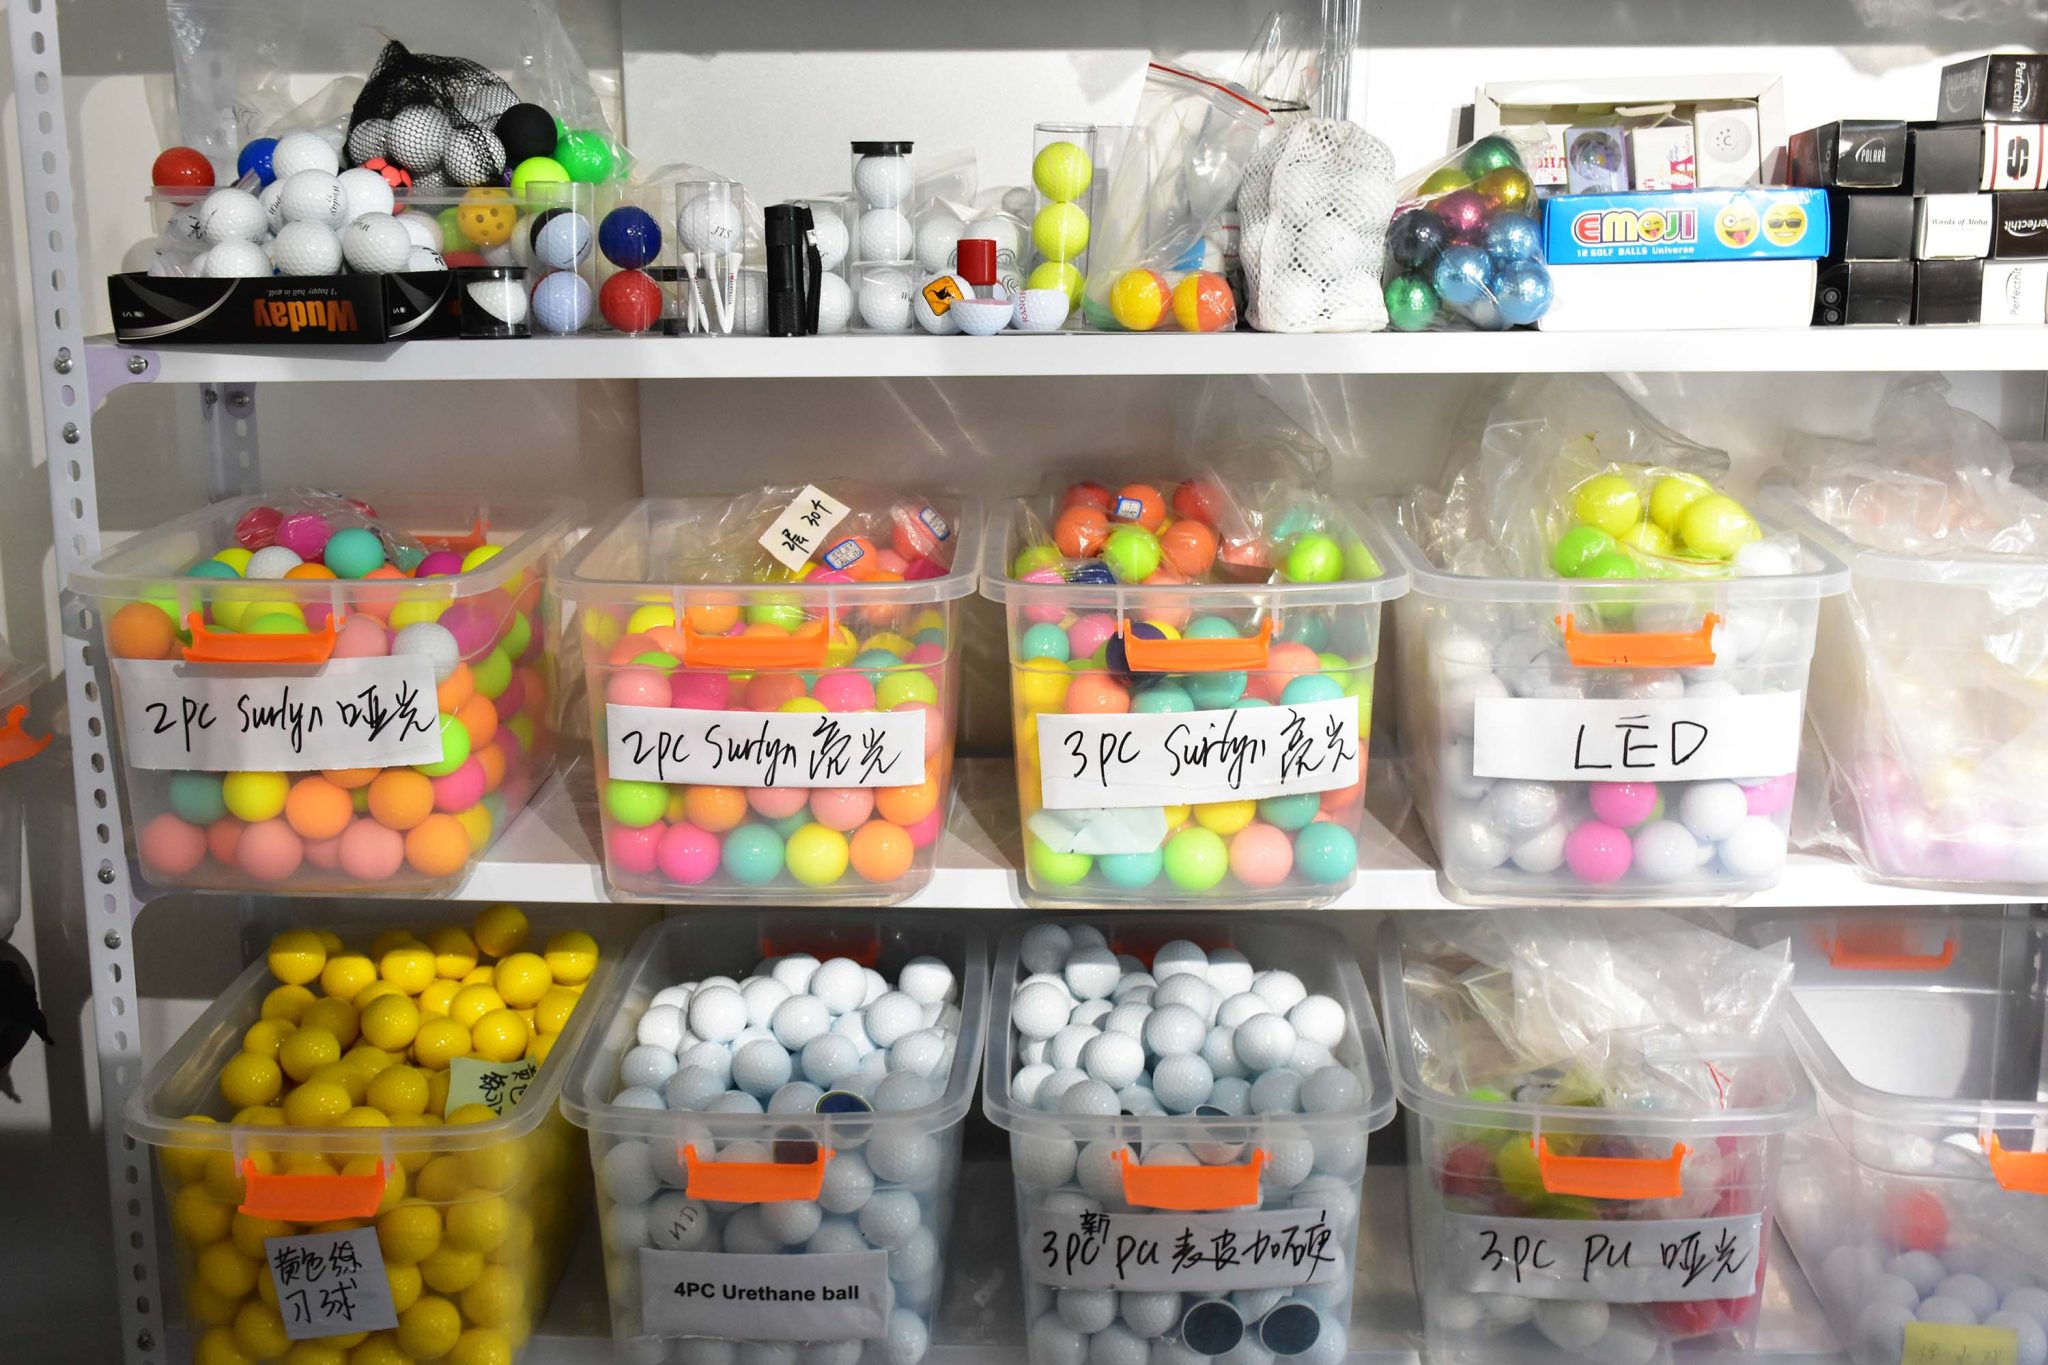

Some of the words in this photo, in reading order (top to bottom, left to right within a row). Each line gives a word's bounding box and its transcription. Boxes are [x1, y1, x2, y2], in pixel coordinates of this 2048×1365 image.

[2012, 61, 2026, 114] Perfecthit
[711, 226, 733, 239] JTS
[1573, 209, 1696, 245] EMOJI
[1590, 248, 1614, 257] GOLF
[1618, 247, 1648, 256] BALLS
[1652, 246, 1695, 255] Universe
[292, 288, 306, 297] ball
[308, 287, 330, 296] happy
[2010, 267, 2022, 316] Perfecthit
[253, 299, 360, 332] Wuday
[1574, 714, 1708, 769] LED
[674, 1282, 716, 1299] 4PC
[723, 1283, 816, 1302] Urethane
[822, 1285, 860, 1301] ball
